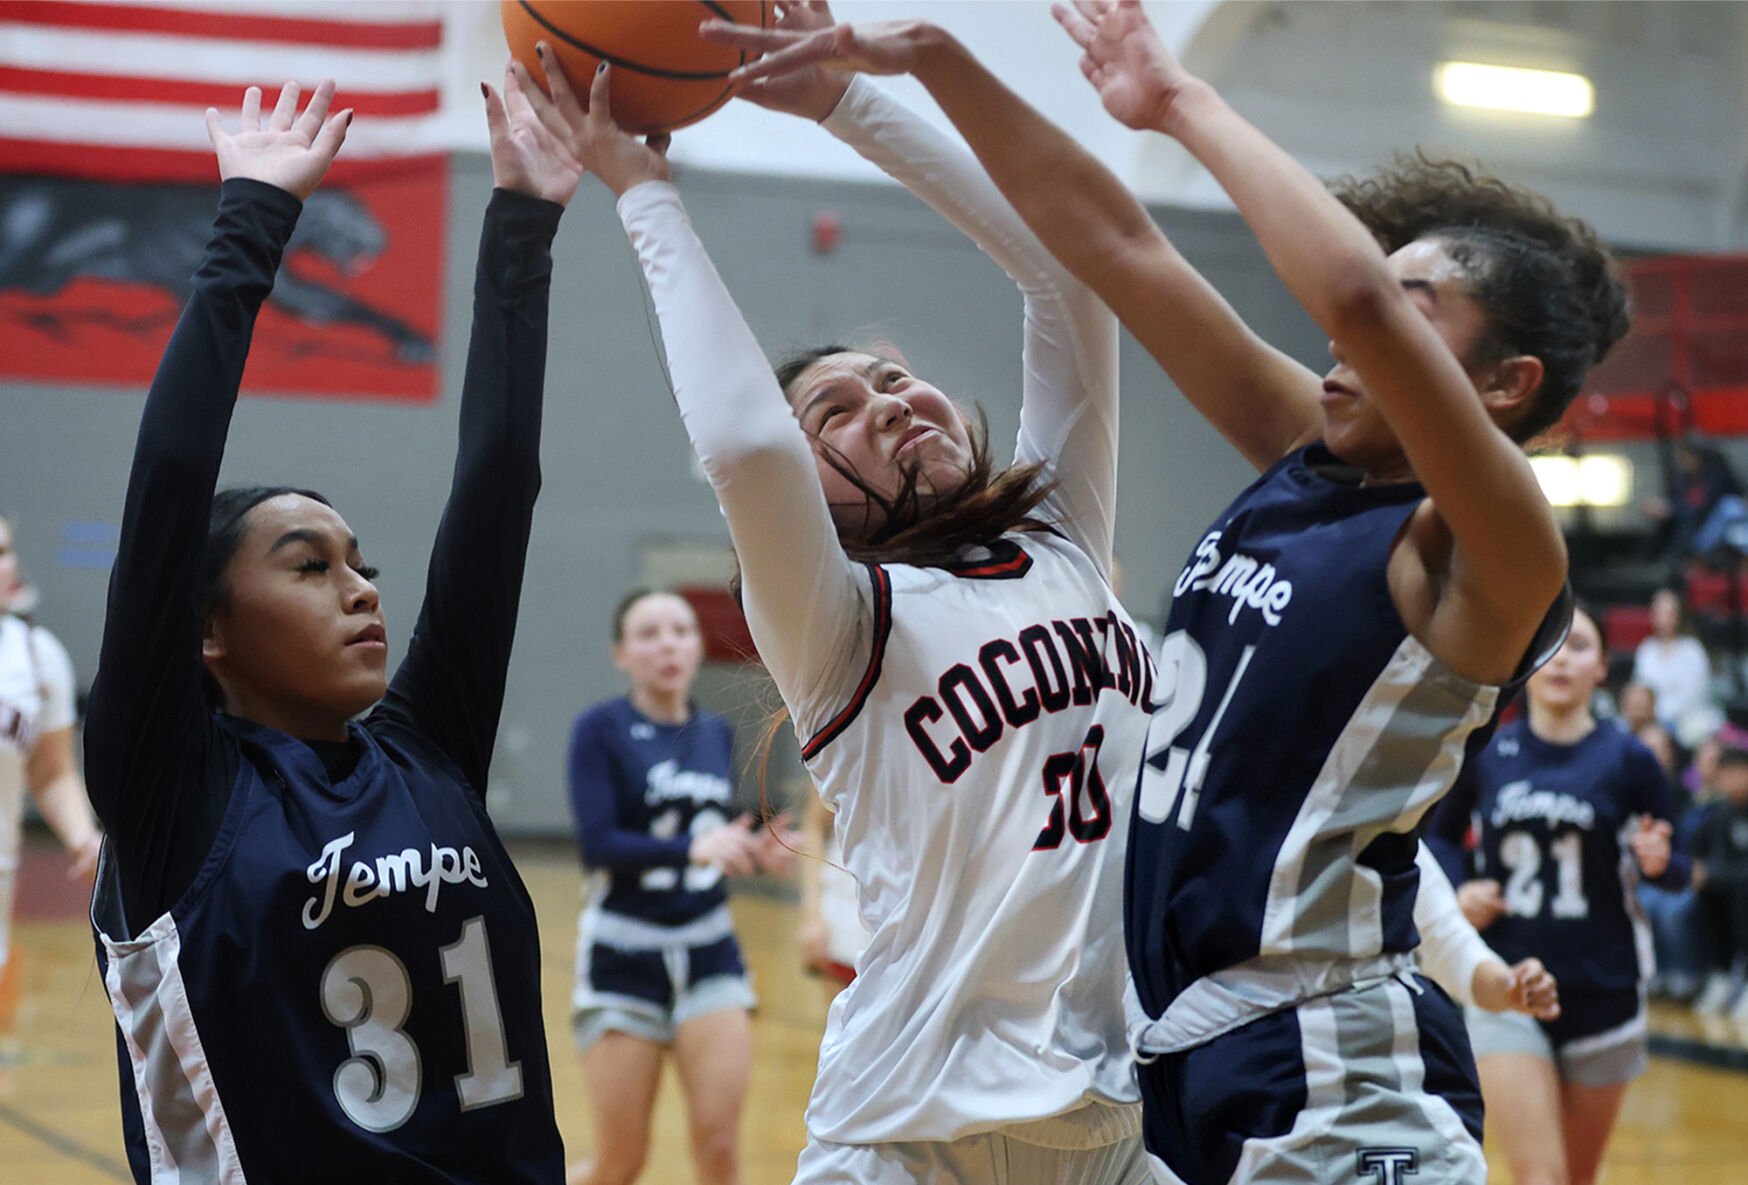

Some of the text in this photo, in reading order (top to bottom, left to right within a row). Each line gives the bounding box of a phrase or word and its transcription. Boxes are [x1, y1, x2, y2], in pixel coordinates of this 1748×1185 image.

[302, 831, 488, 930] Tempe
[1500, 830, 1589, 918] 21
[319, 914, 524, 1133] 31
